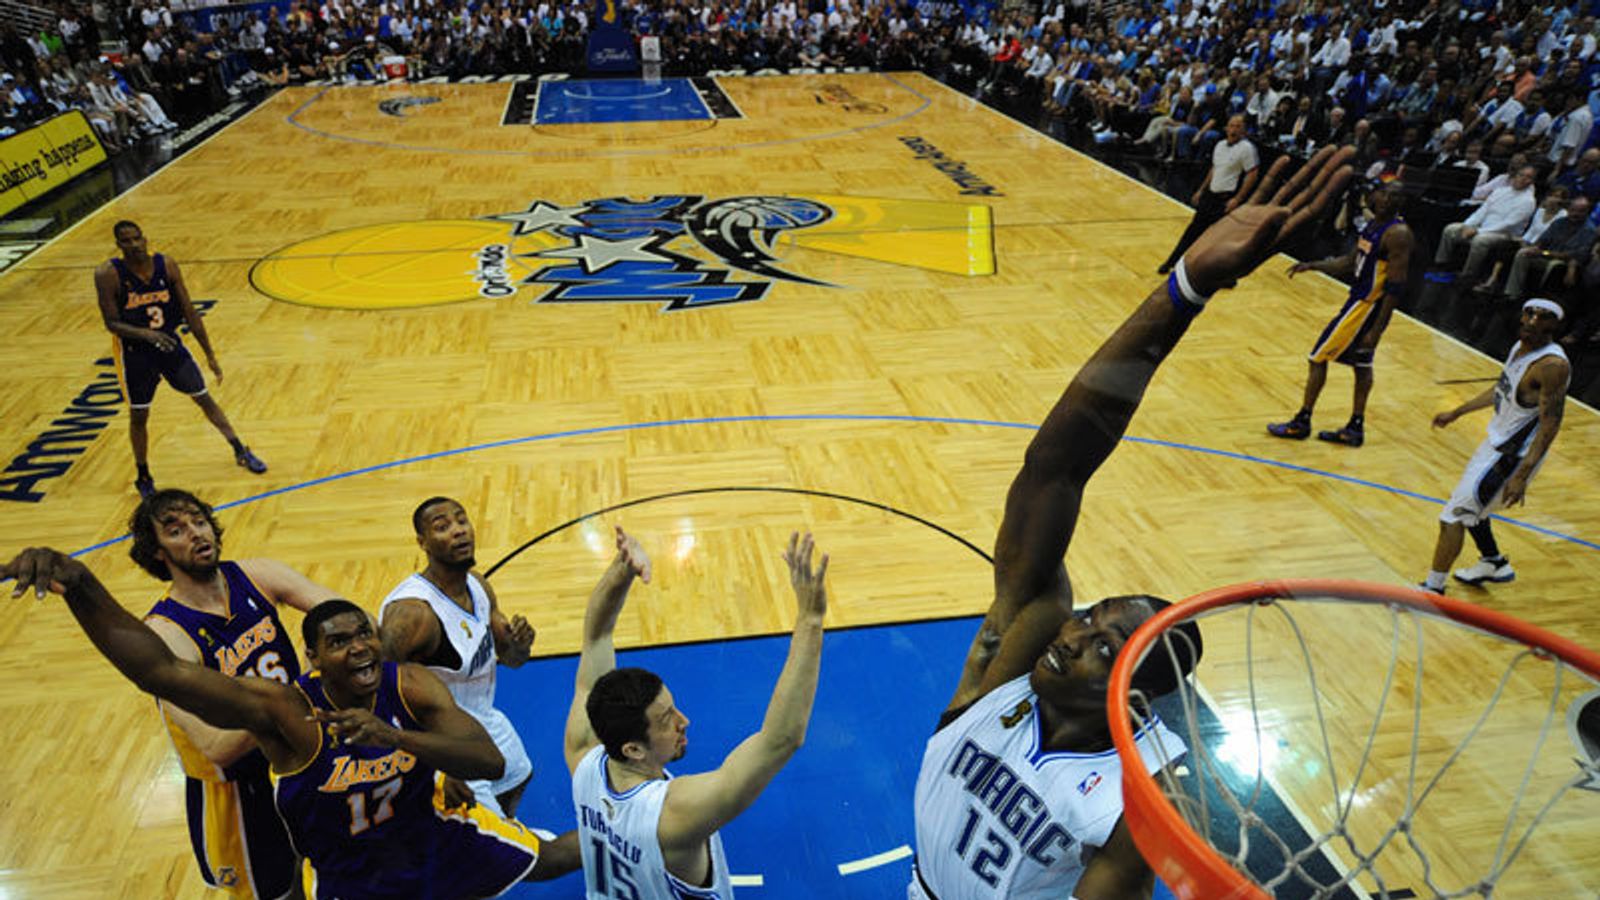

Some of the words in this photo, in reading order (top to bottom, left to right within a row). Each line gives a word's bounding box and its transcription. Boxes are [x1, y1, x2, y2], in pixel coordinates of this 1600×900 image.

[39, 133, 96, 168] happens
[145, 304, 165, 331] 3
[214, 614, 276, 678] LAKERS
[317, 749, 416, 793] LAKERS
[347, 776, 403, 836] 17
[948, 737, 1076, 868] MAGIC
[591, 834, 641, 900] 15
[956, 804, 1013, 890] 12
